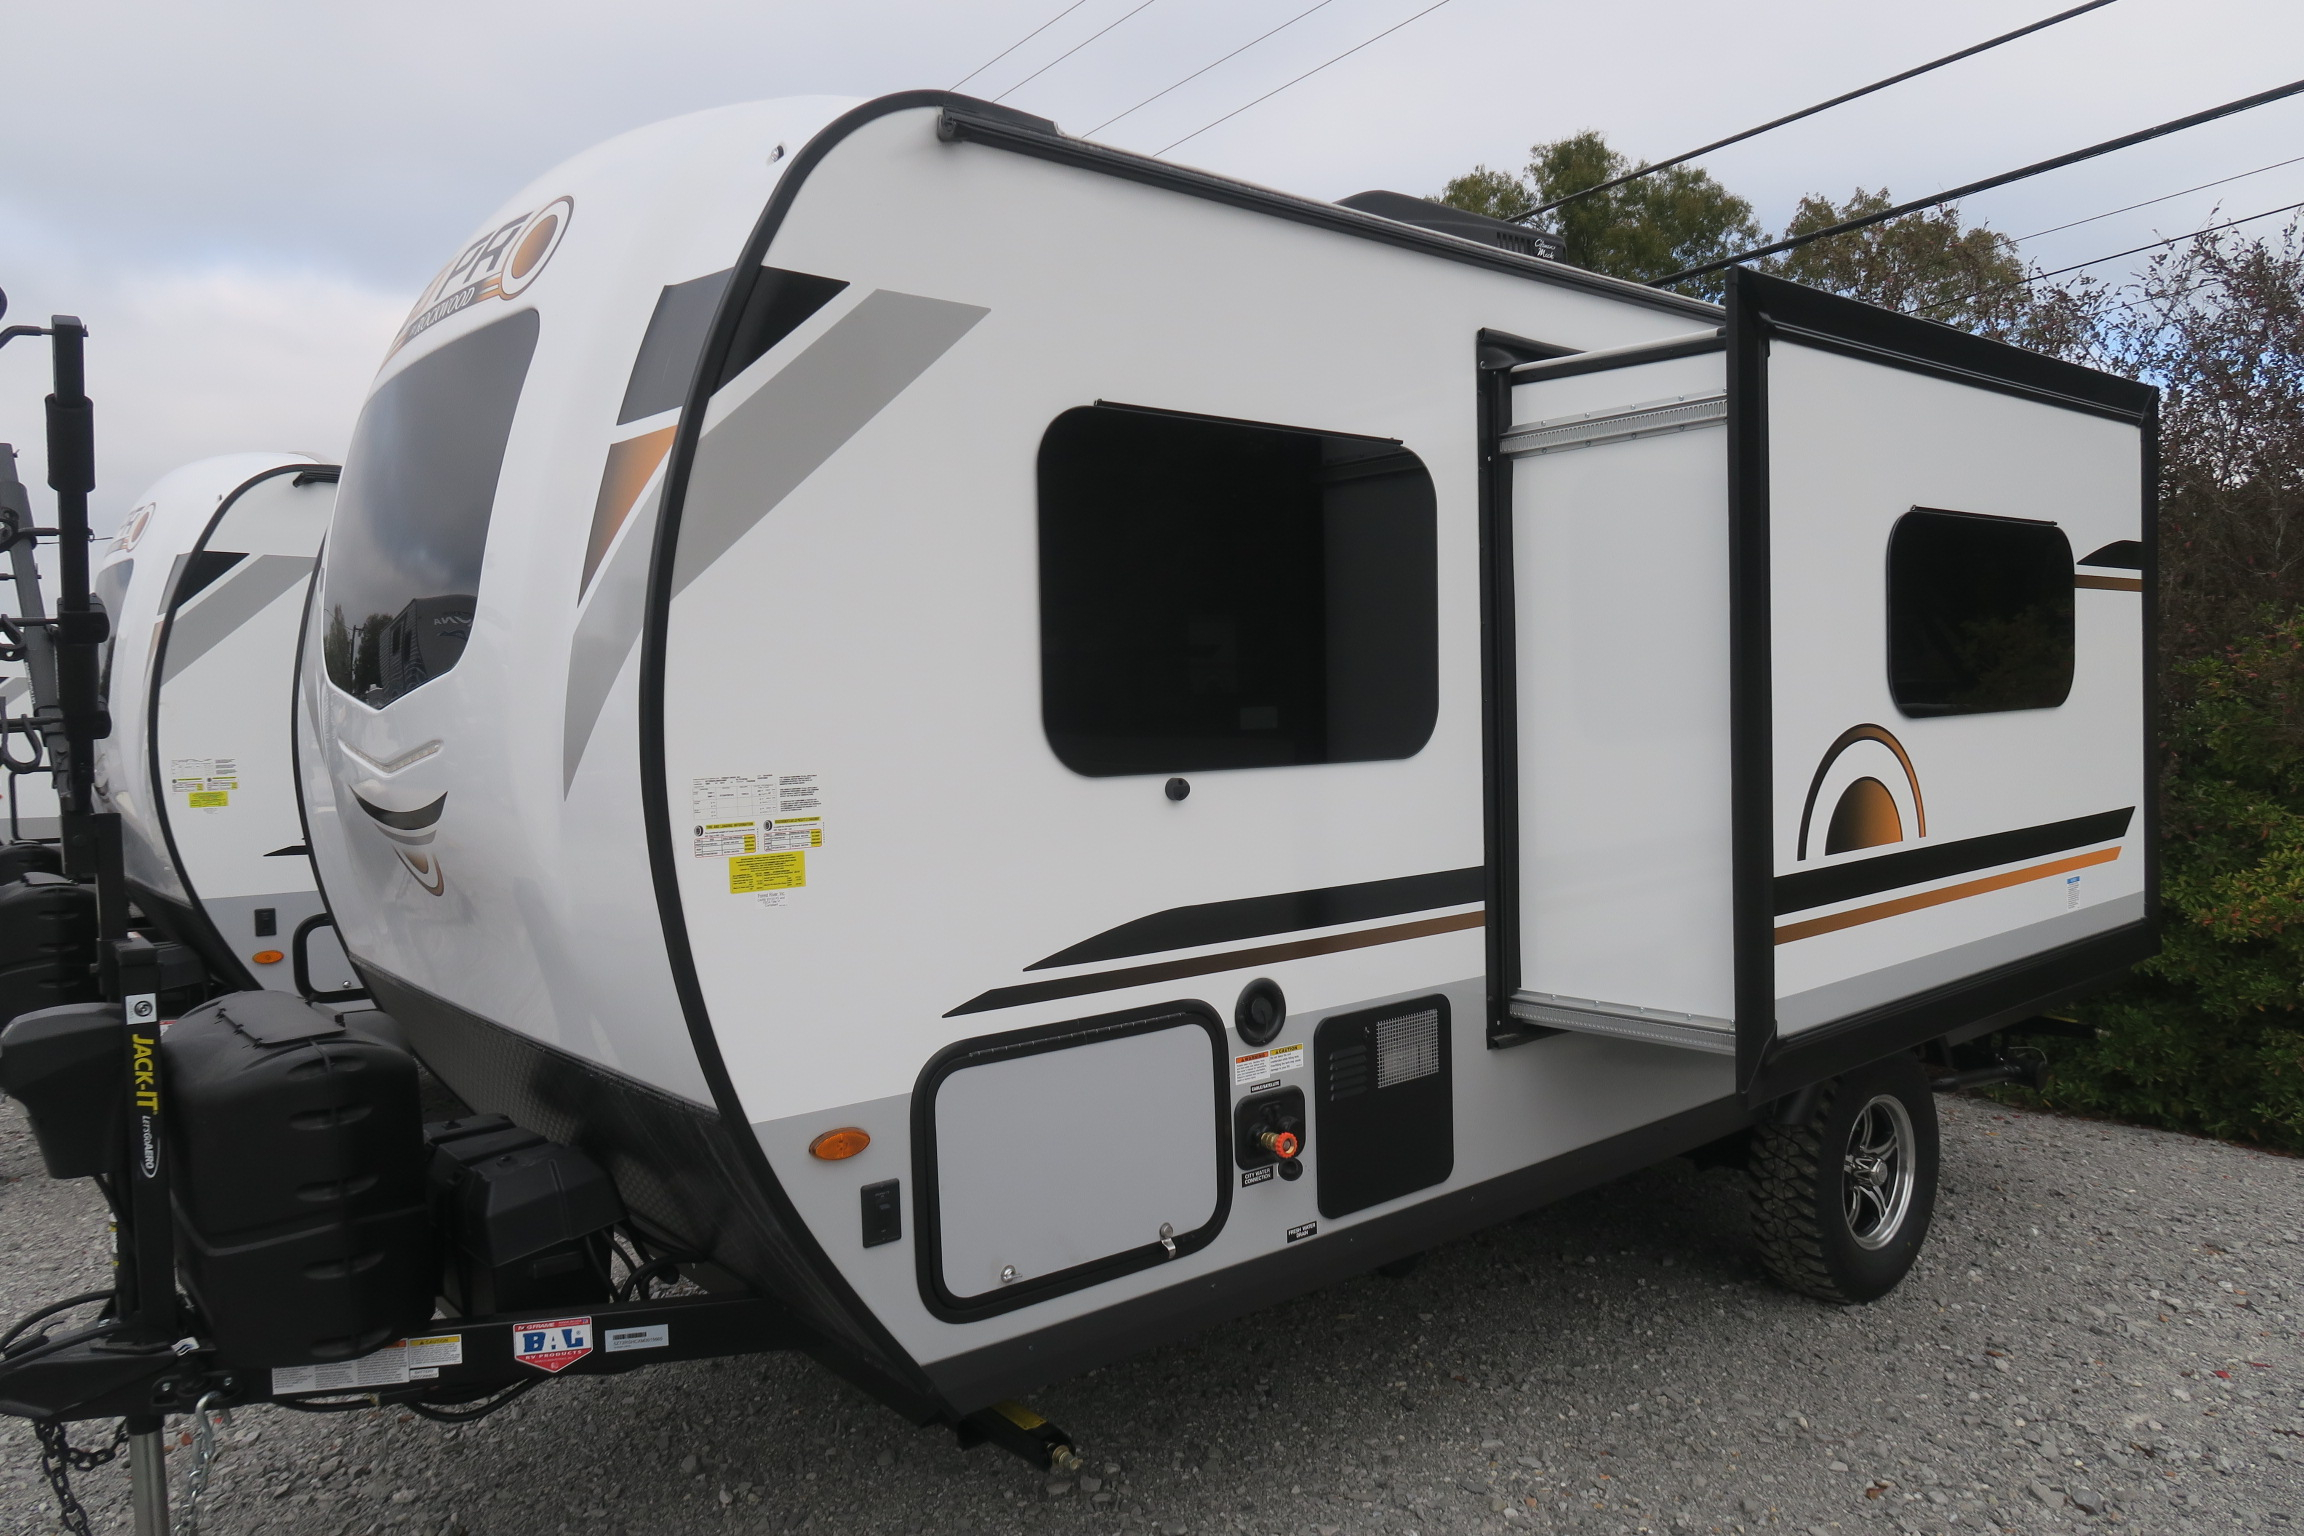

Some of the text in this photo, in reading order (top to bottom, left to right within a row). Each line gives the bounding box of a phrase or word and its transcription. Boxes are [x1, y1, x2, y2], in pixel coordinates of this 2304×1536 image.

[414, 287, 476, 334] ROCKWOOD
[1244, 1168, 1271, 1180] CITY WATER
[1244, 1174, 1271, 1185] CONNECTION
[1288, 1222, 1316, 1236] FRESH WATER
[523, 1328, 584, 1353] BAL
[538, 1350, 582, 1358] PRODUCTS
